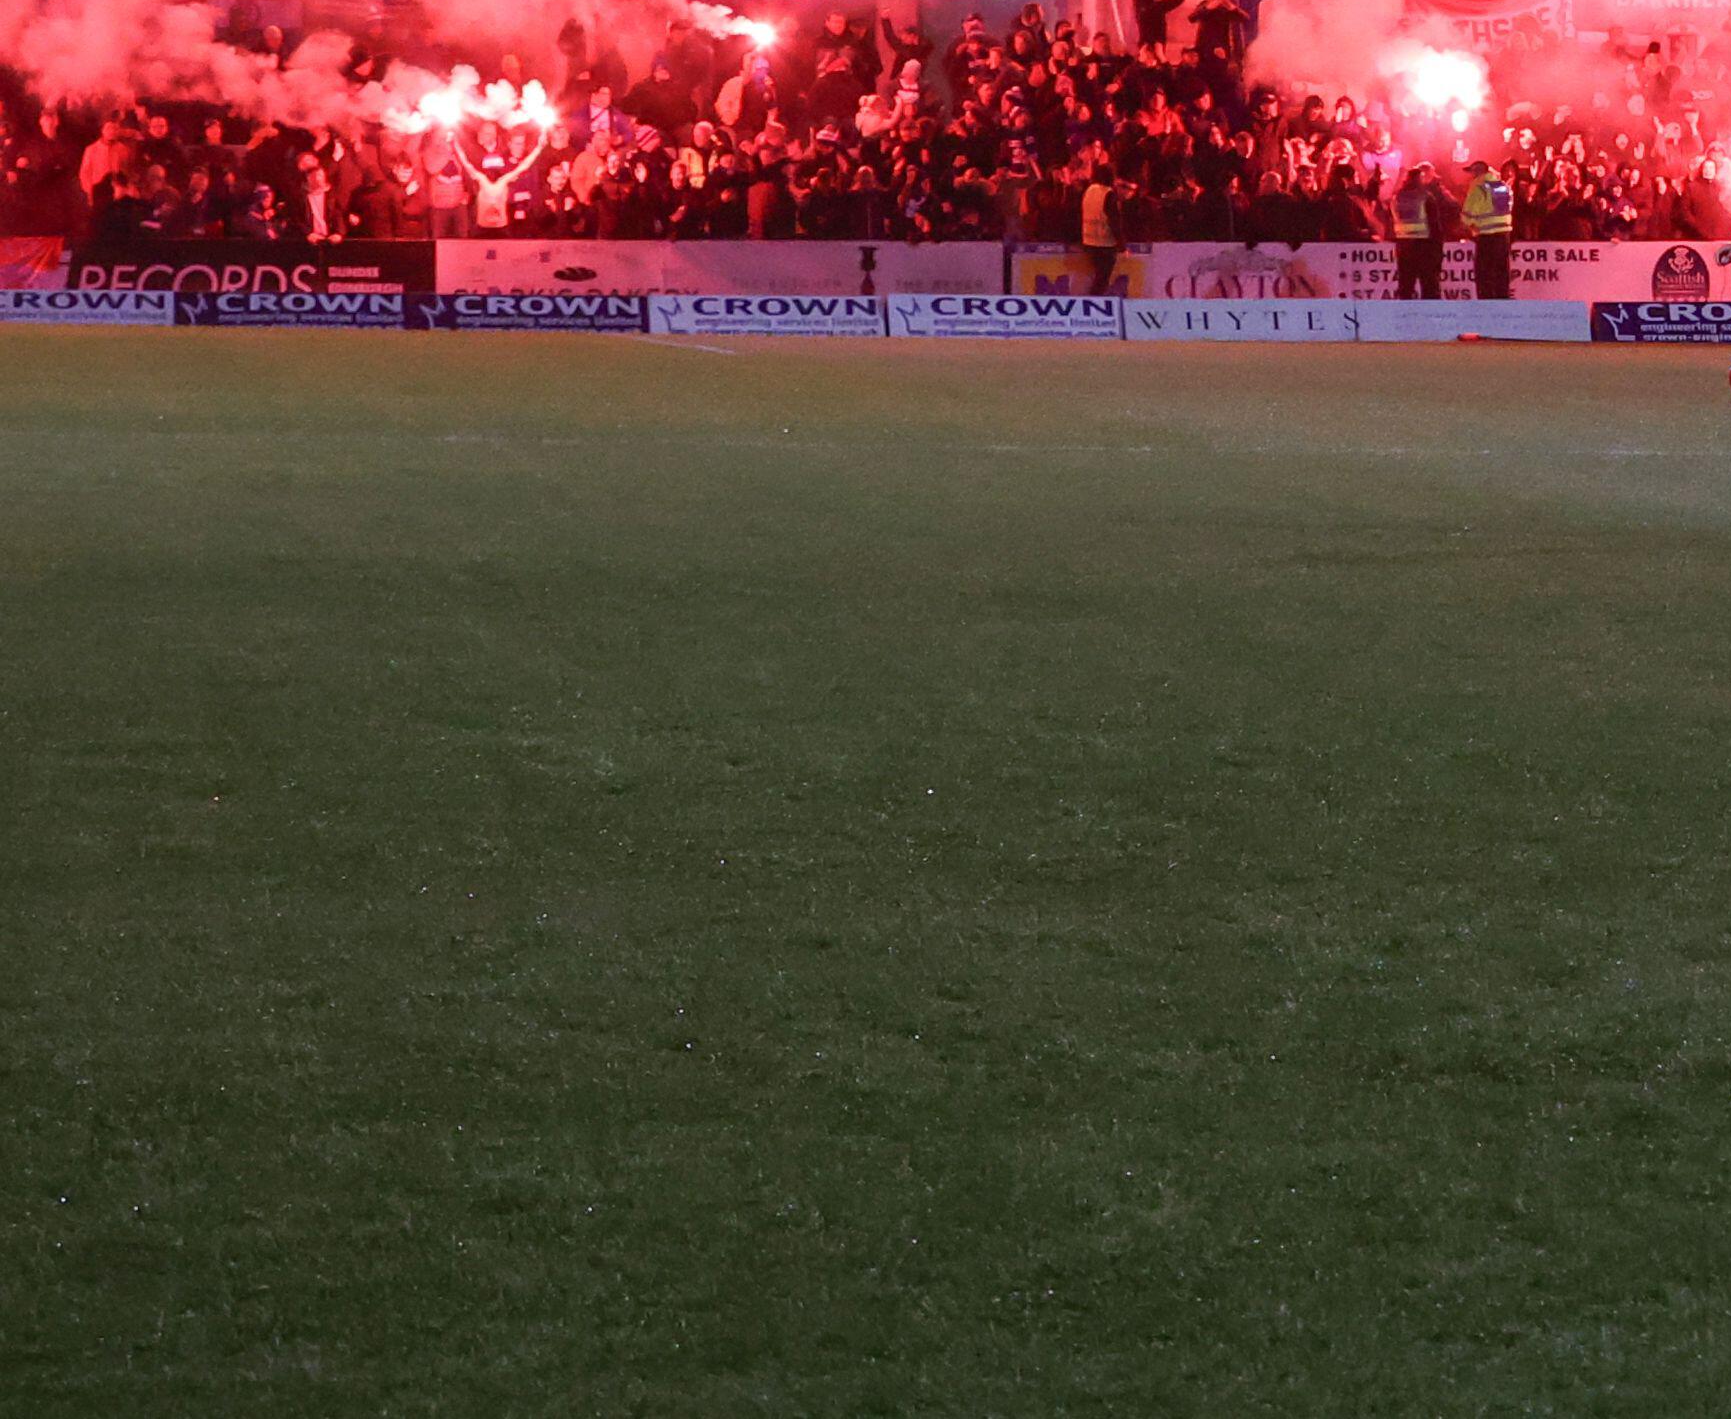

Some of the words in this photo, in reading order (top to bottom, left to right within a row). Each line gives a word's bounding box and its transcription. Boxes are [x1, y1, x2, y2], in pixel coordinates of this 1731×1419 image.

[1511, 249, 1548, 263] FOR
[1555, 249, 1600, 263] SALE
[79, 264, 317, 293] RECORDS
[1513, 269, 1560, 281] PARK
[216, 293, 402, 313] CROWN
[454, 296, 640, 315] CROWN
[692, 298, 877, 316] CROWN
[931, 298, 1113, 317] CROWN
[1137, 310, 1361, 331] WHYTES
